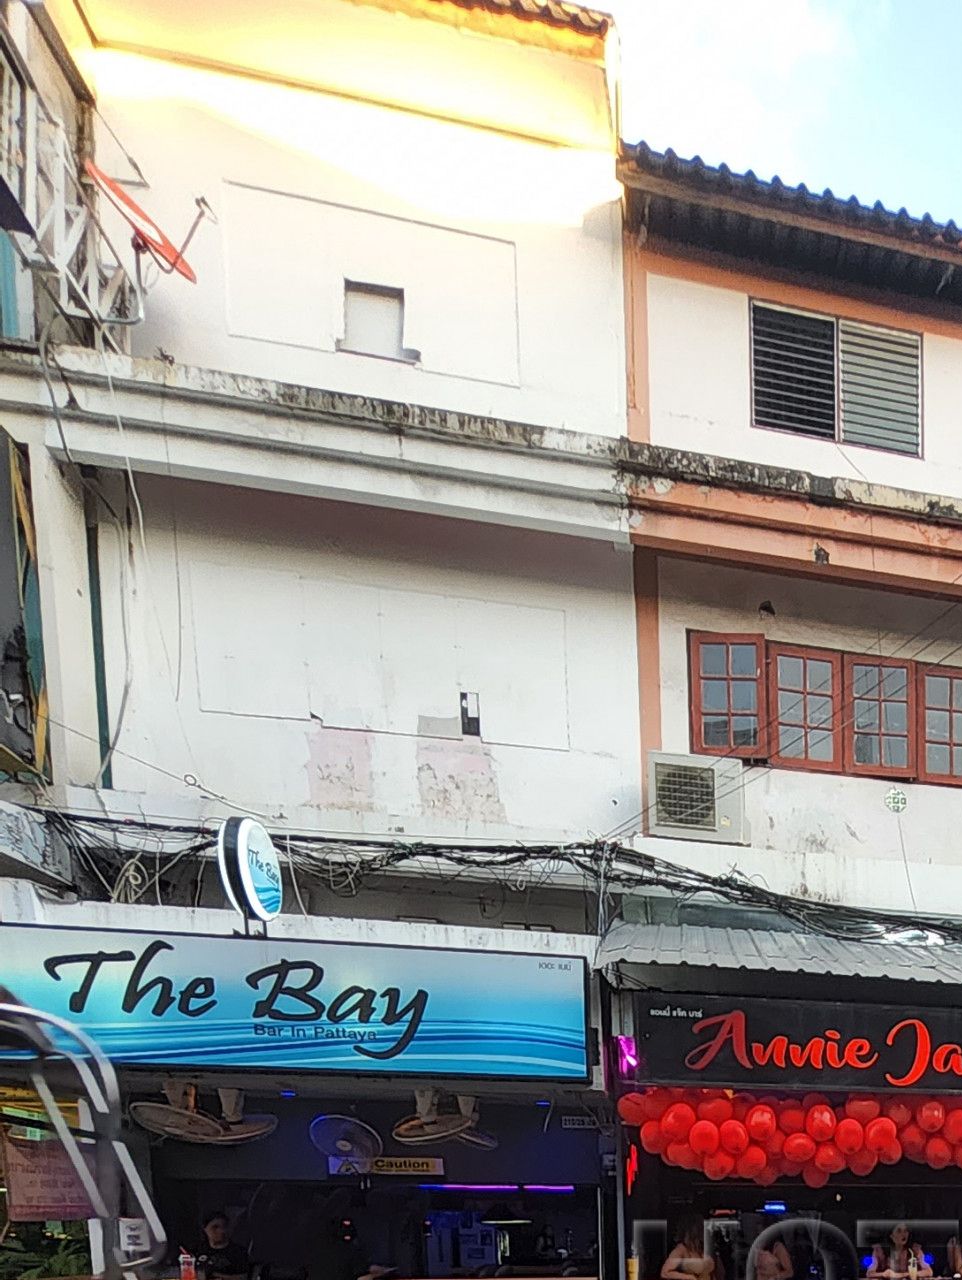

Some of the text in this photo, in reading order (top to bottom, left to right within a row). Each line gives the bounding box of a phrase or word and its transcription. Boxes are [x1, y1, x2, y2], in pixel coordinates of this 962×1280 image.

[43, 939, 429, 1061] The Bay
[254, 1024, 377, 1042] Bar In Pattaya
[685, 1009, 879, 1070] Annie
[375, 1160, 430, 1169] Caution
